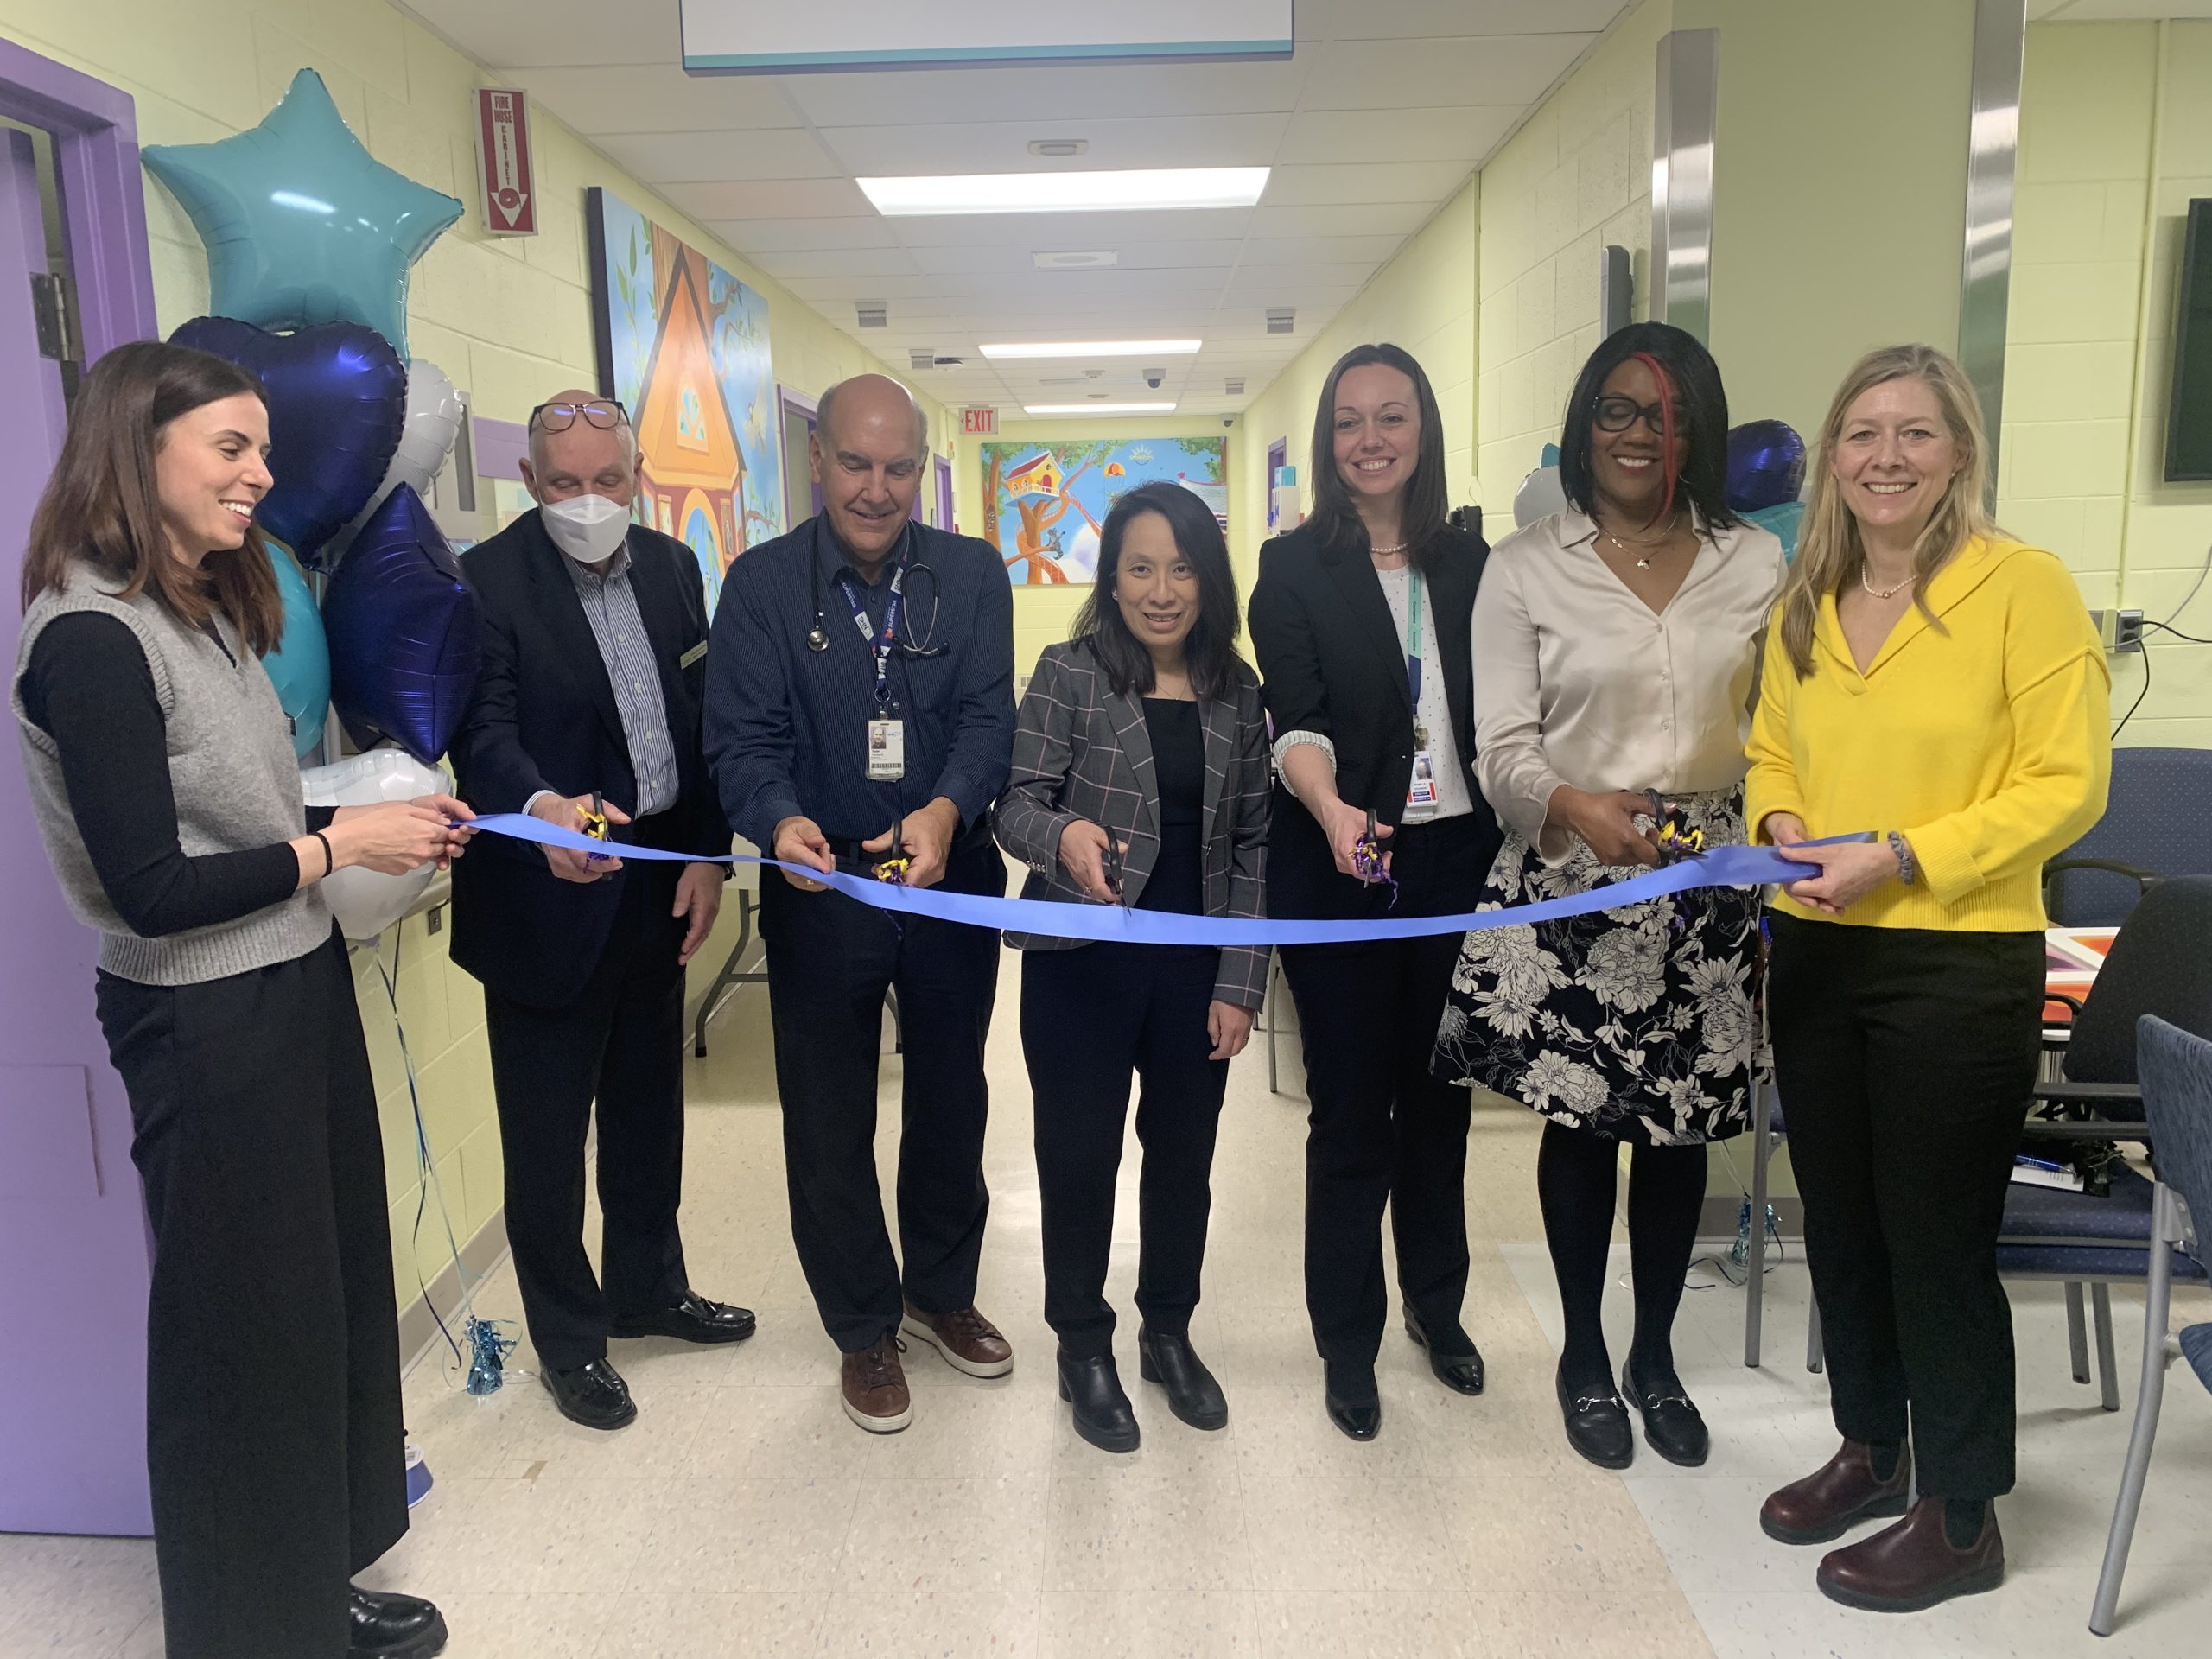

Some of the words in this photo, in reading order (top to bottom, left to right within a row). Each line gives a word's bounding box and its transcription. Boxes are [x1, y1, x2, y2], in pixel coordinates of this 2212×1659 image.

[494, 95, 510, 109] FIRE
[494, 110, 512, 124] HOSE
[501, 125, 511, 186] CABINET
[964, 410, 994, 432] EXIT
[859, 615, 868, 631] SHN
[887, 600, 897, 628] SUPERSTAR
